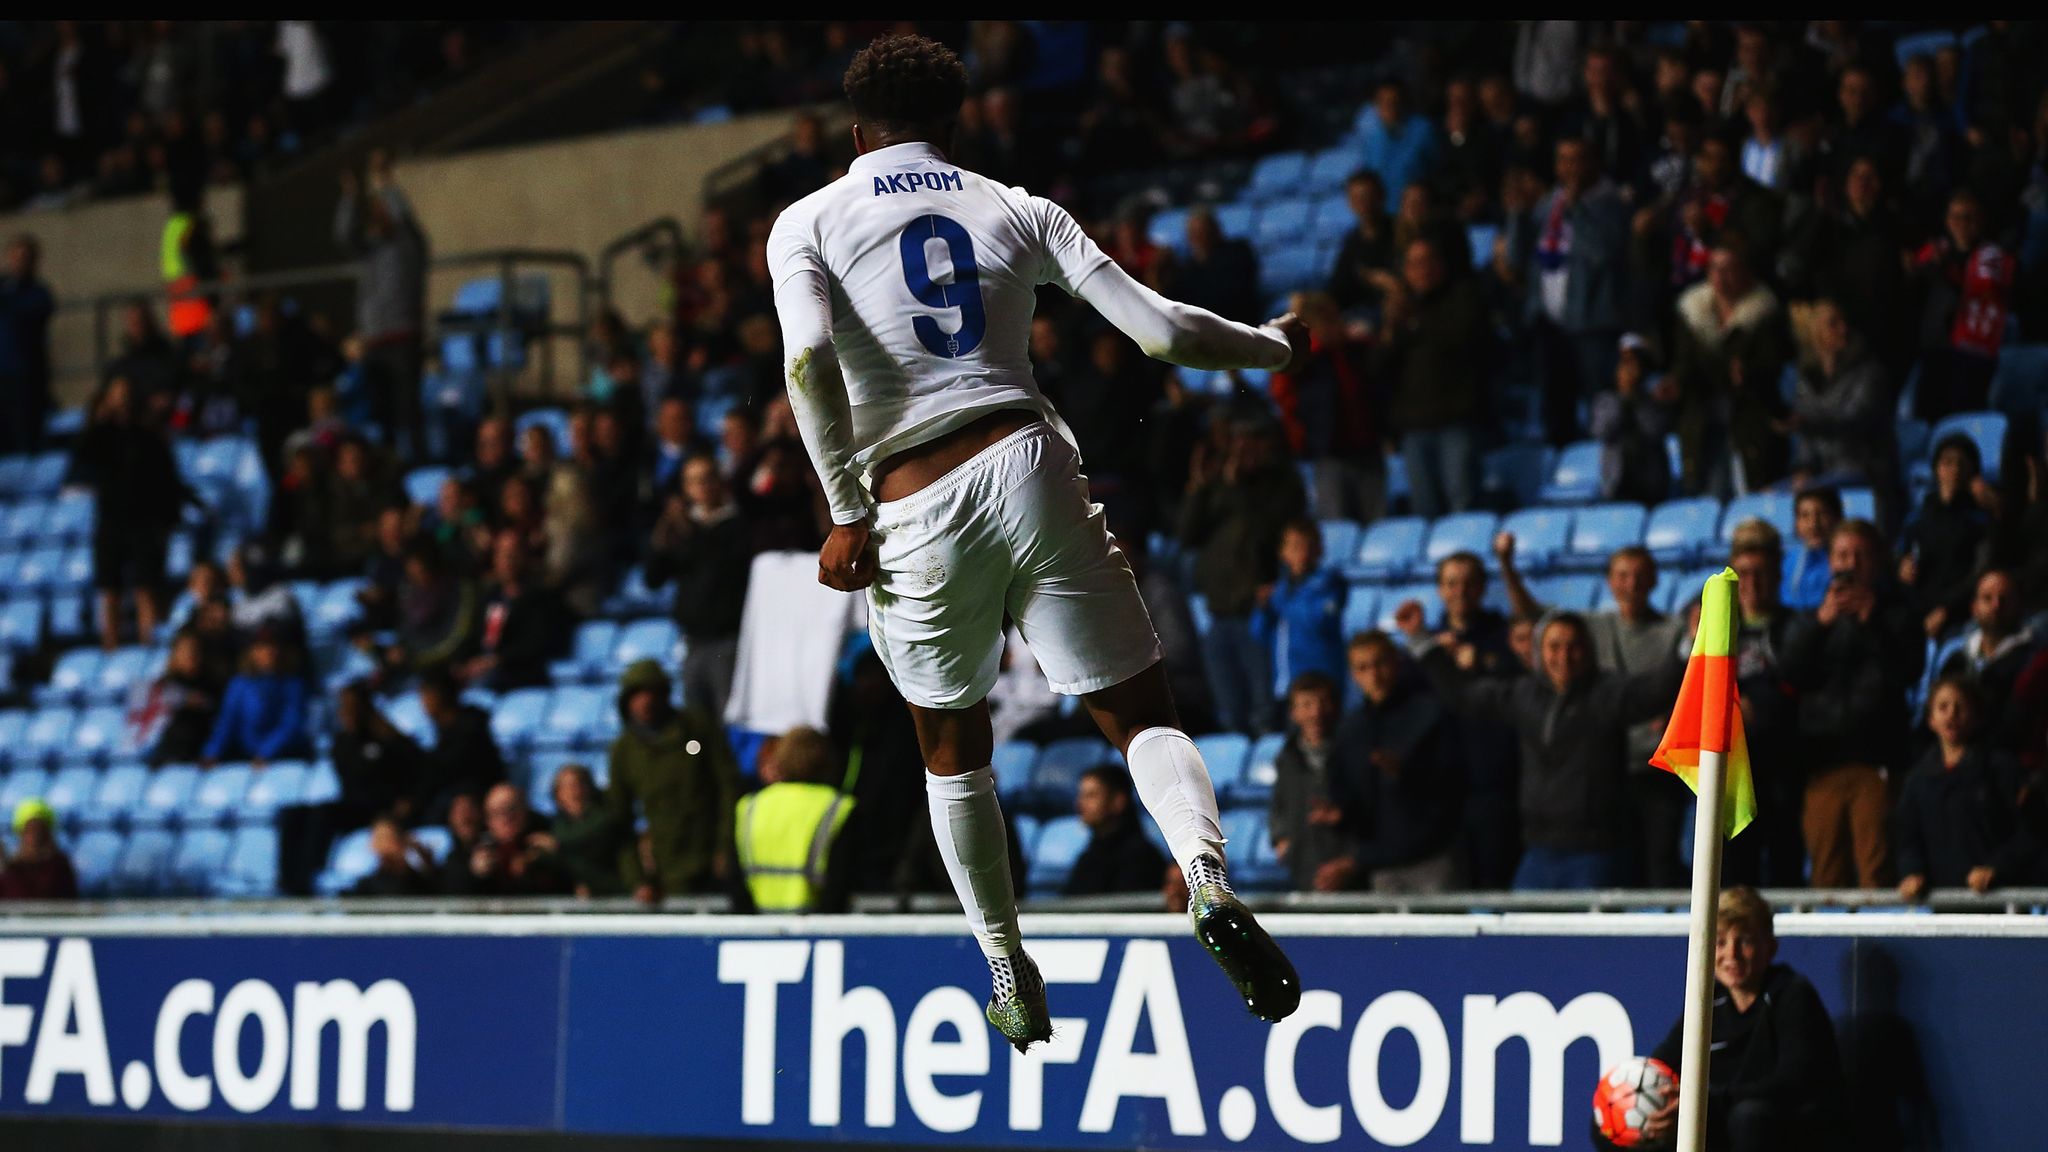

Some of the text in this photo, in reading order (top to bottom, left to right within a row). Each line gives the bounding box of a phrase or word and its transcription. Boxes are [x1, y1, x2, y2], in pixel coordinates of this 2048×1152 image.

[873, 171, 964, 197] AKPOM
[900, 214, 986, 359] 9
[717, 939, 1635, 1147] TheFA.com
